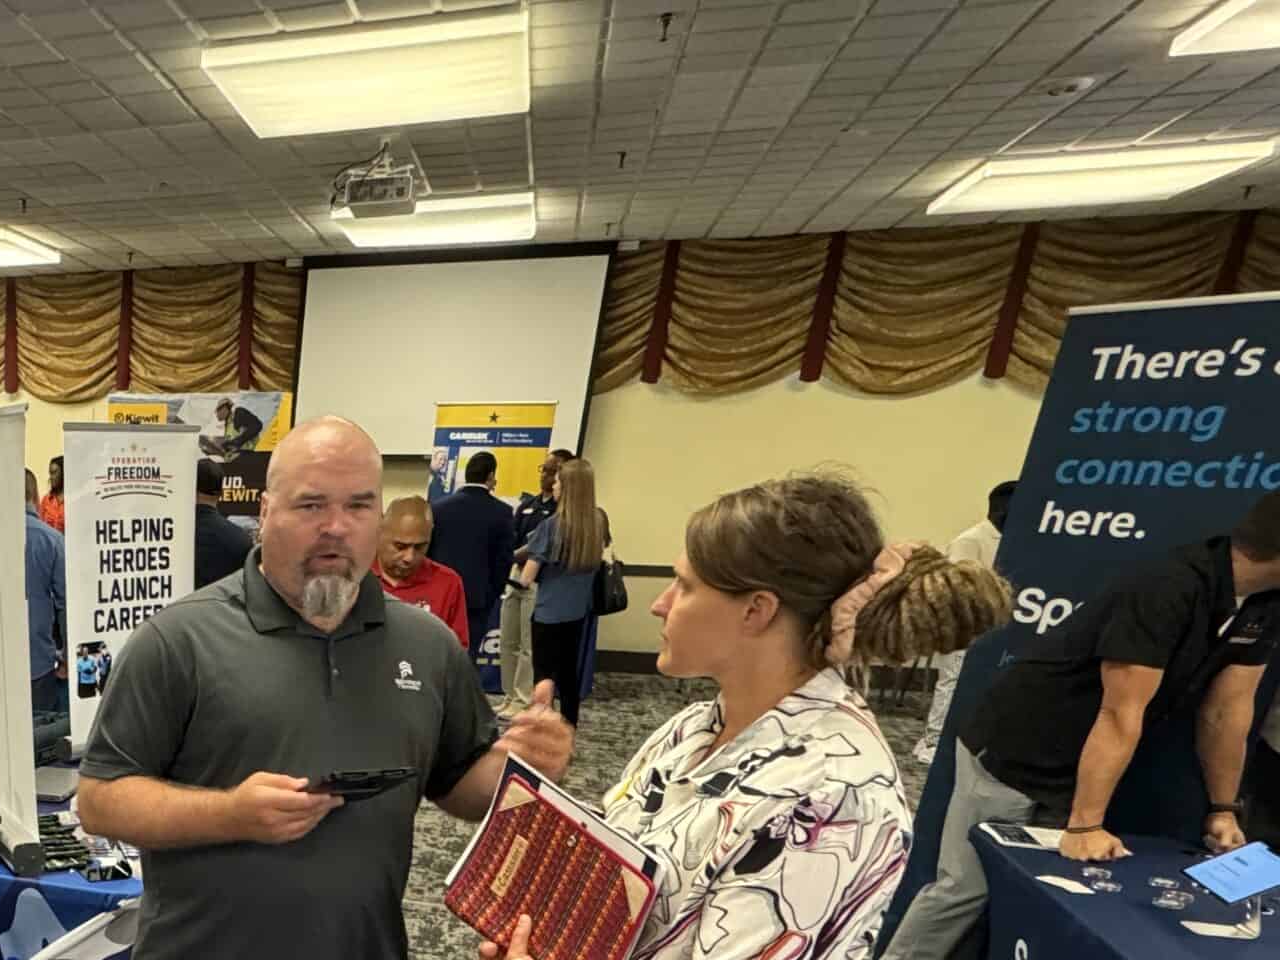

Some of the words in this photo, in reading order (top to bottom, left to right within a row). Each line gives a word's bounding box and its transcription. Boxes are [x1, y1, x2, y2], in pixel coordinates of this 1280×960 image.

[1091, 337, 1266, 381] There's
[1070, 401, 1227, 442] strong
[107, 466, 161, 481] FREEDOM
[222, 476, 246, 489] UD.
[219, 488, 261, 502] EWIT.
[95, 518, 174, 544] HELPING
[1038, 501, 1146, 539] here.
[99, 546, 170, 574] HEROES
[97, 575, 172, 603] LAUNCH
